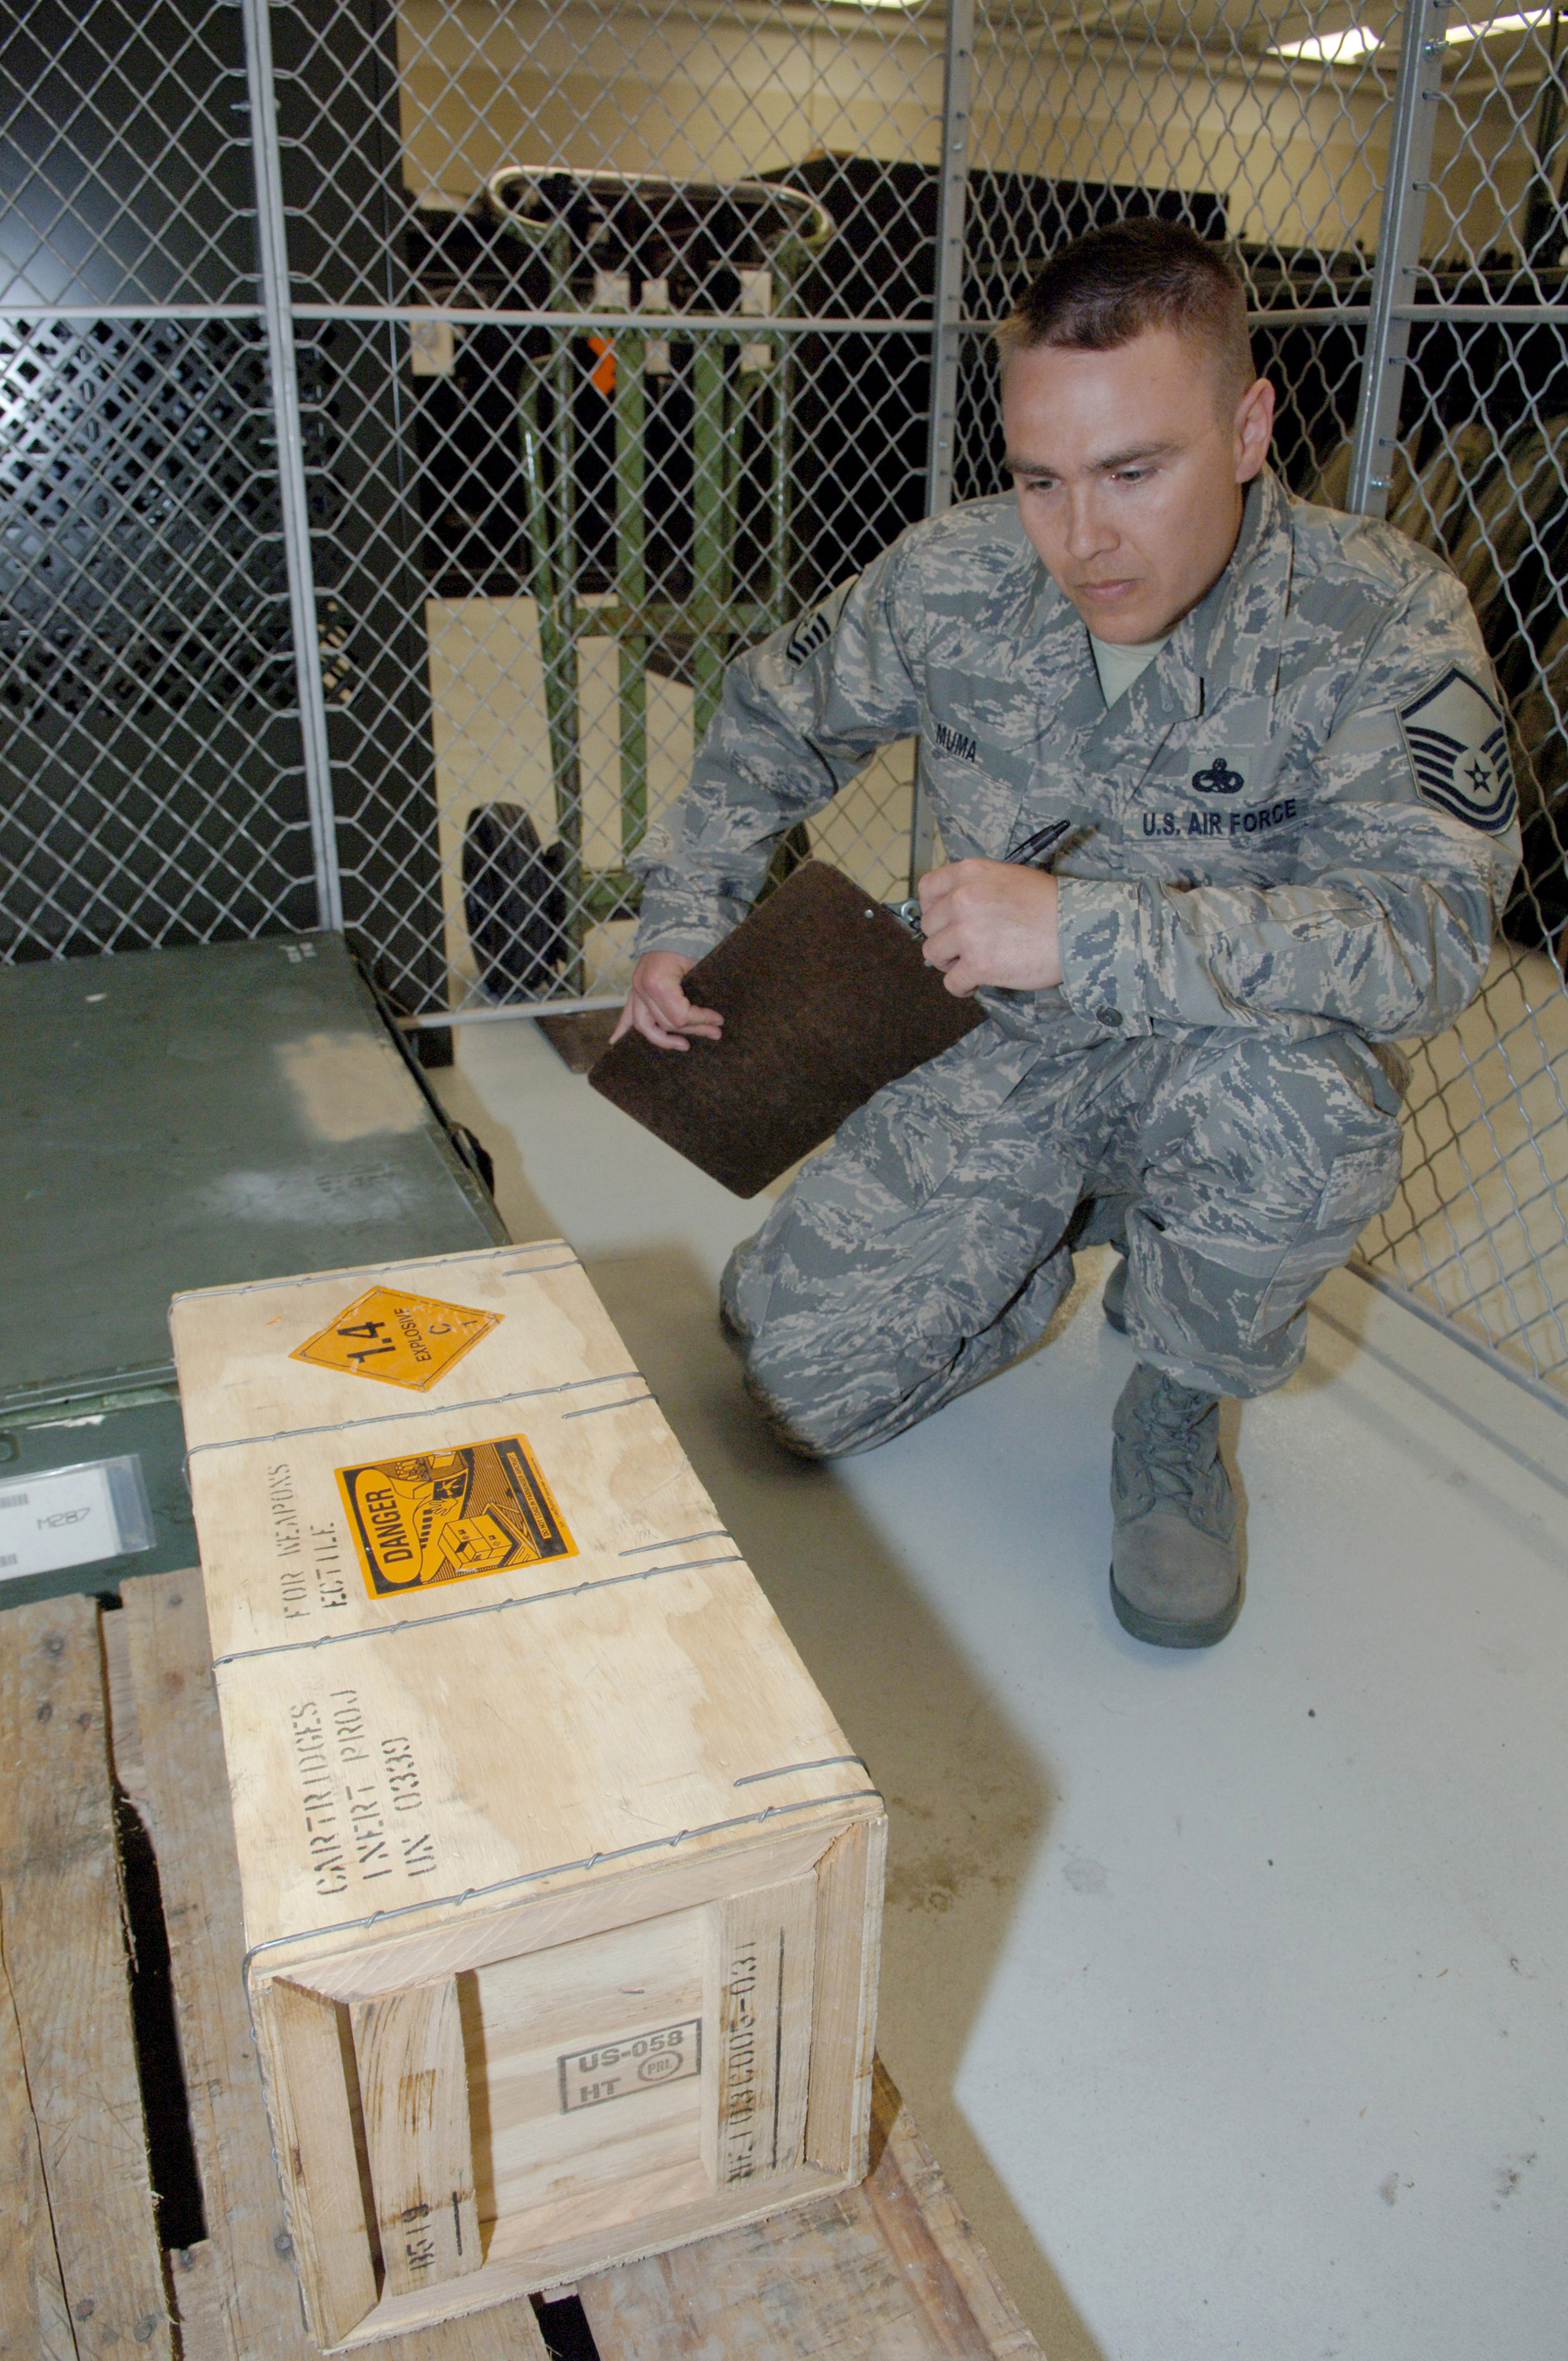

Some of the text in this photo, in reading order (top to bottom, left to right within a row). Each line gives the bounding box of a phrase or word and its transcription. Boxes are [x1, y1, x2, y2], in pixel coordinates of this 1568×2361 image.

[935, 723, 978, 764] MUMA
[1142, 798, 1297, 837] U.S. AIR FORCE
[337, 1321, 396, 1363] 1.4
[393, 1307, 432, 1362] EXPLOSIVE
[37, 1507, 90, 1531] M287
[364, 1487, 413, 1565] DANGER
[267, 1464, 348, 1894] CARTRIDGES FOR WEAPONS
[330, 1690, 370, 1763] PROJ
[381, 1736, 437, 1877] UN 0339
[345, 1785, 393, 1880] INERT
[578, 2030, 684, 2074] US-058
[579, 2076, 622, 2103] HT
